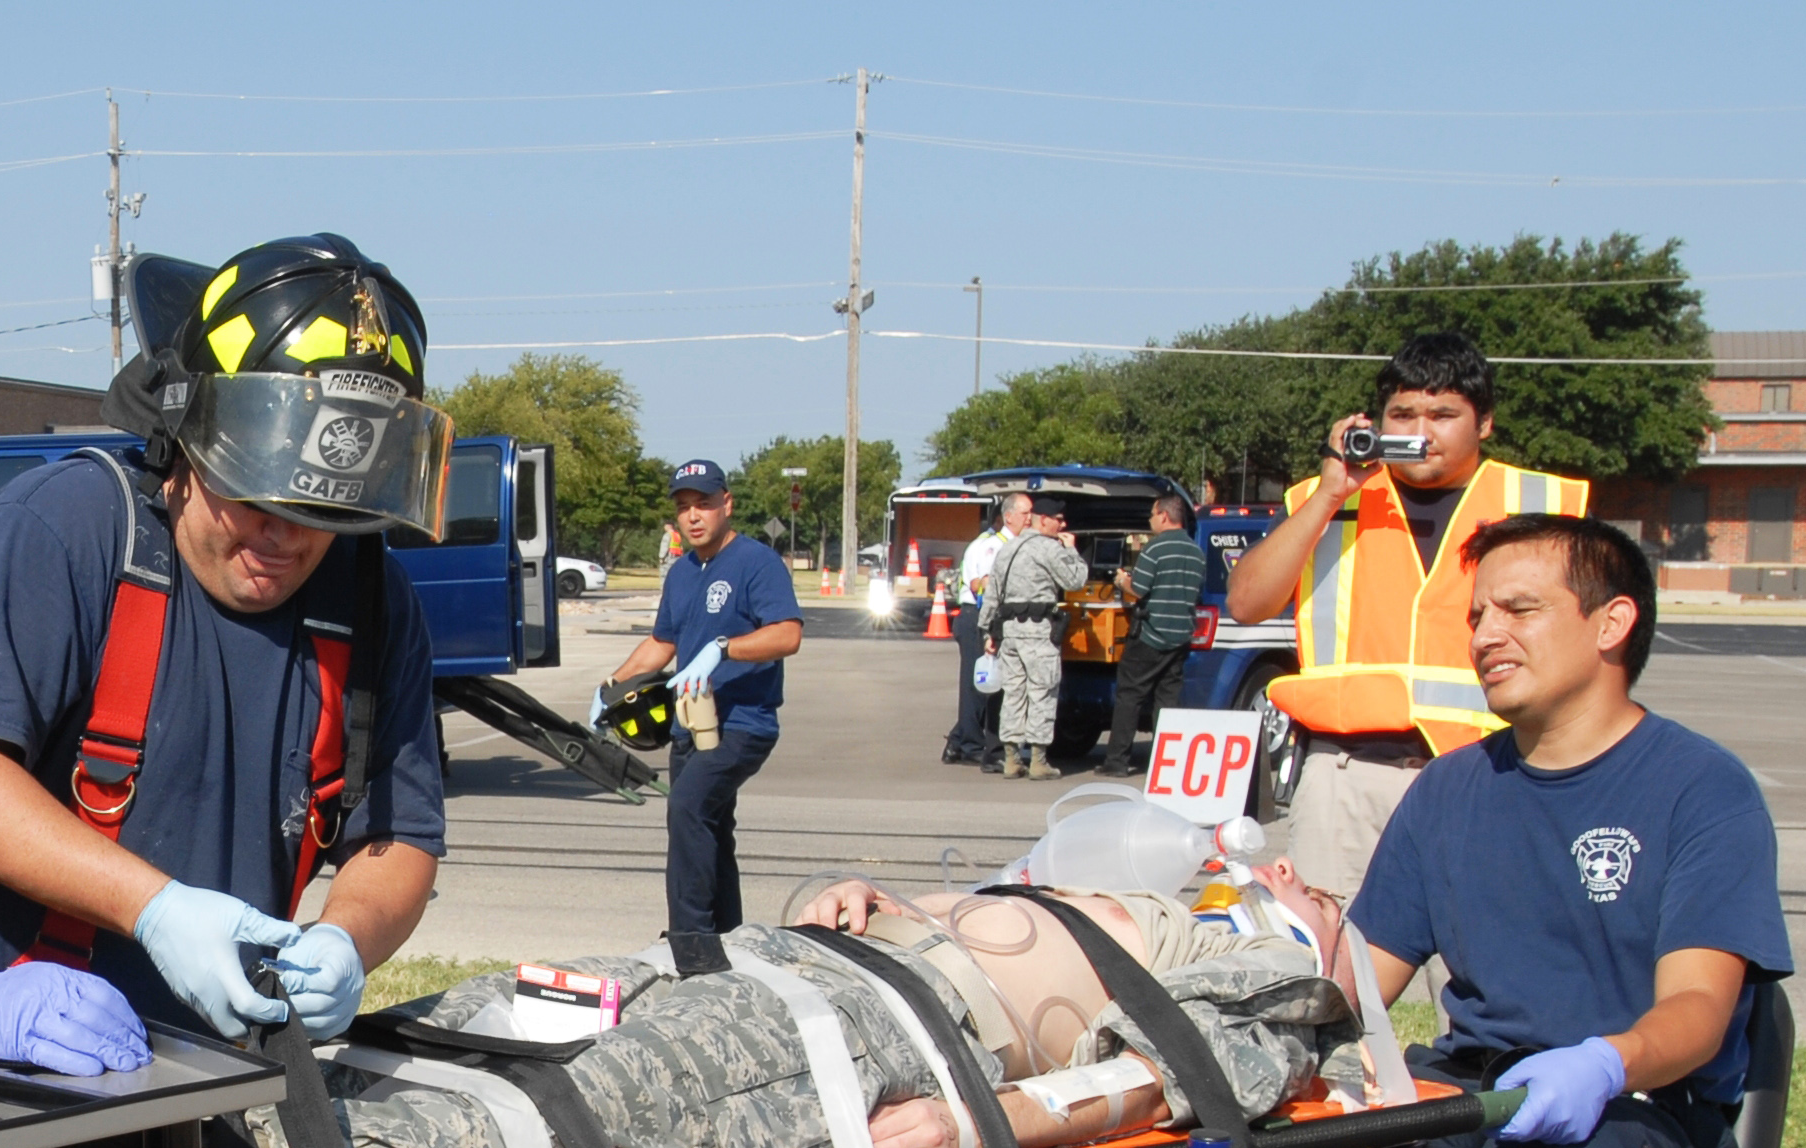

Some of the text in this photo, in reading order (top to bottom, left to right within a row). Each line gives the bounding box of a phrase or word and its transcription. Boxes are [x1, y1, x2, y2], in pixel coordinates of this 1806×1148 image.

[293, 470, 362, 501] GAFB
[1210, 534, 1248, 547] CHIEF 1
[1147, 732, 1252, 798] ECP
